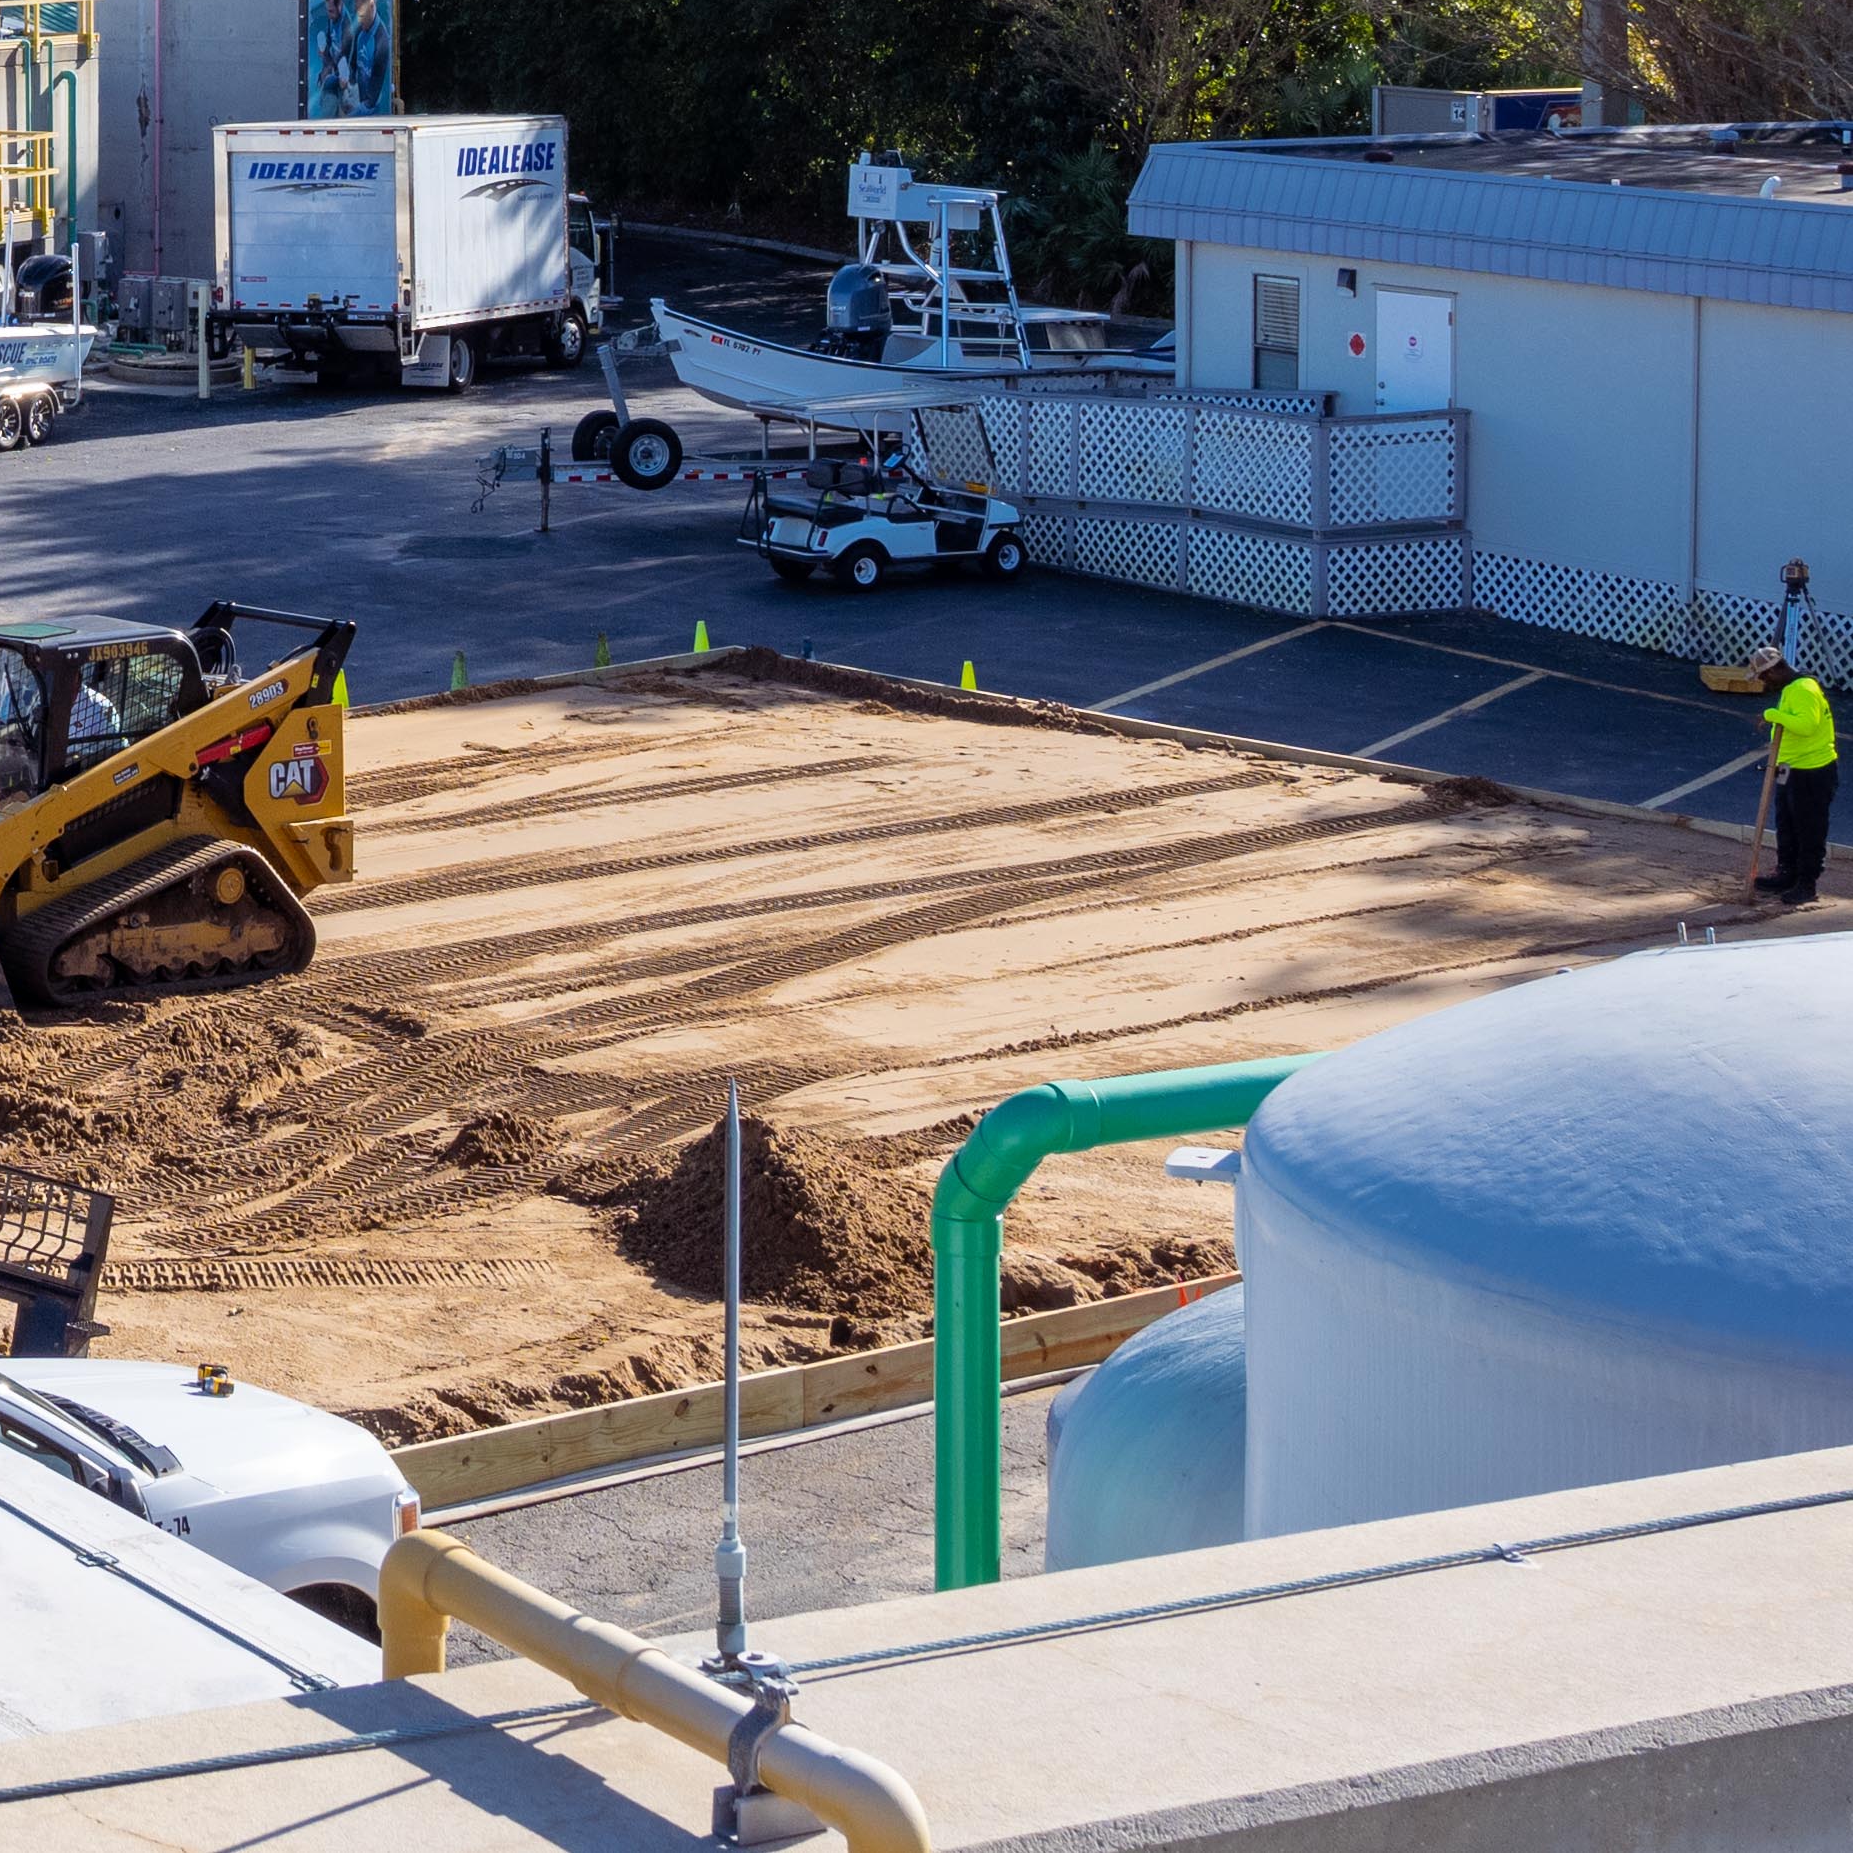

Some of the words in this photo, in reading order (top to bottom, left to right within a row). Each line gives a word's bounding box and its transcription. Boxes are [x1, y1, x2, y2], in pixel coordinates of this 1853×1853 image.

[248, 162, 380, 180] IDEALEASE
[457, 142, 556, 177] IDEALEASE
[88, 641, 149, 662] JX903946
[249, 682, 285, 709] 289D3
[270, 758, 314, 799] CAT
